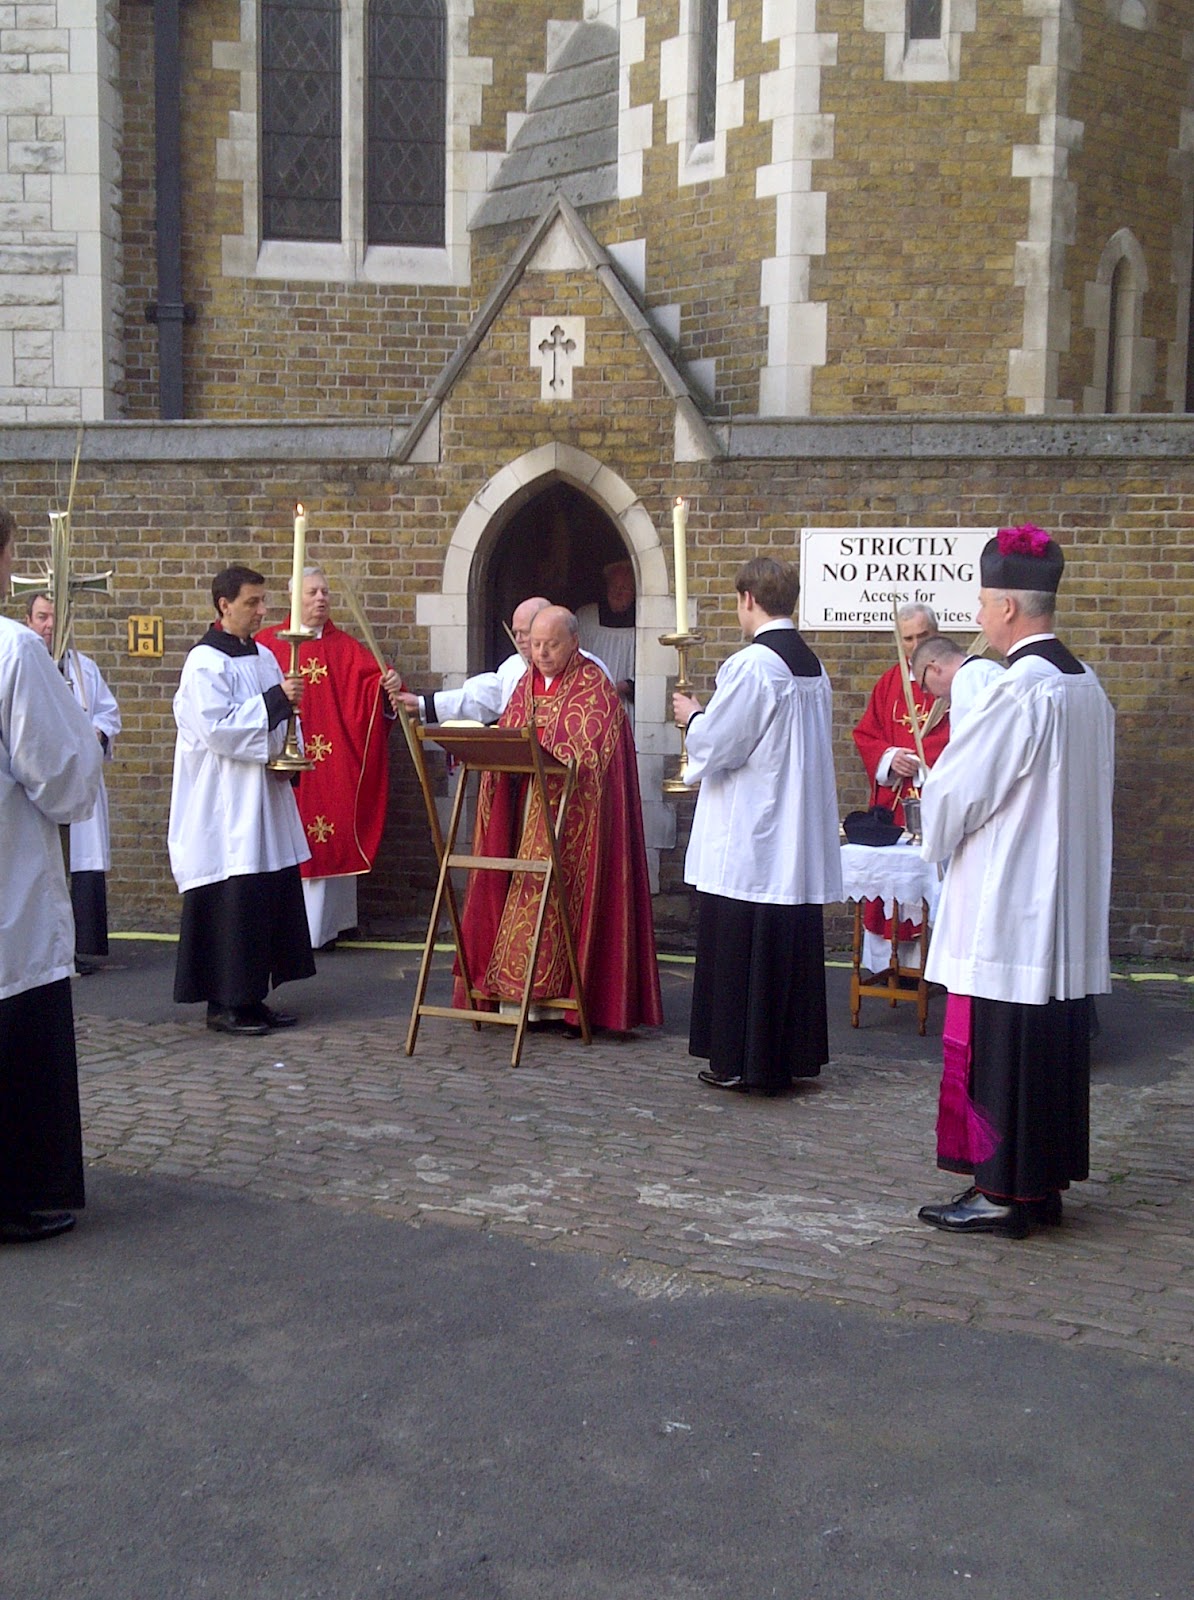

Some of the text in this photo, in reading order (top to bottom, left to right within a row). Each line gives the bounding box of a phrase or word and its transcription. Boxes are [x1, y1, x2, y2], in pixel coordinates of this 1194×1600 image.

[840, 537, 958, 556] STRICTLY
[822, 563, 974, 582] NO PARKING
[859, 588, 936, 603] Access for
[823, 607, 897, 624] Emergenc
[142, 641, 149, 650] 6
